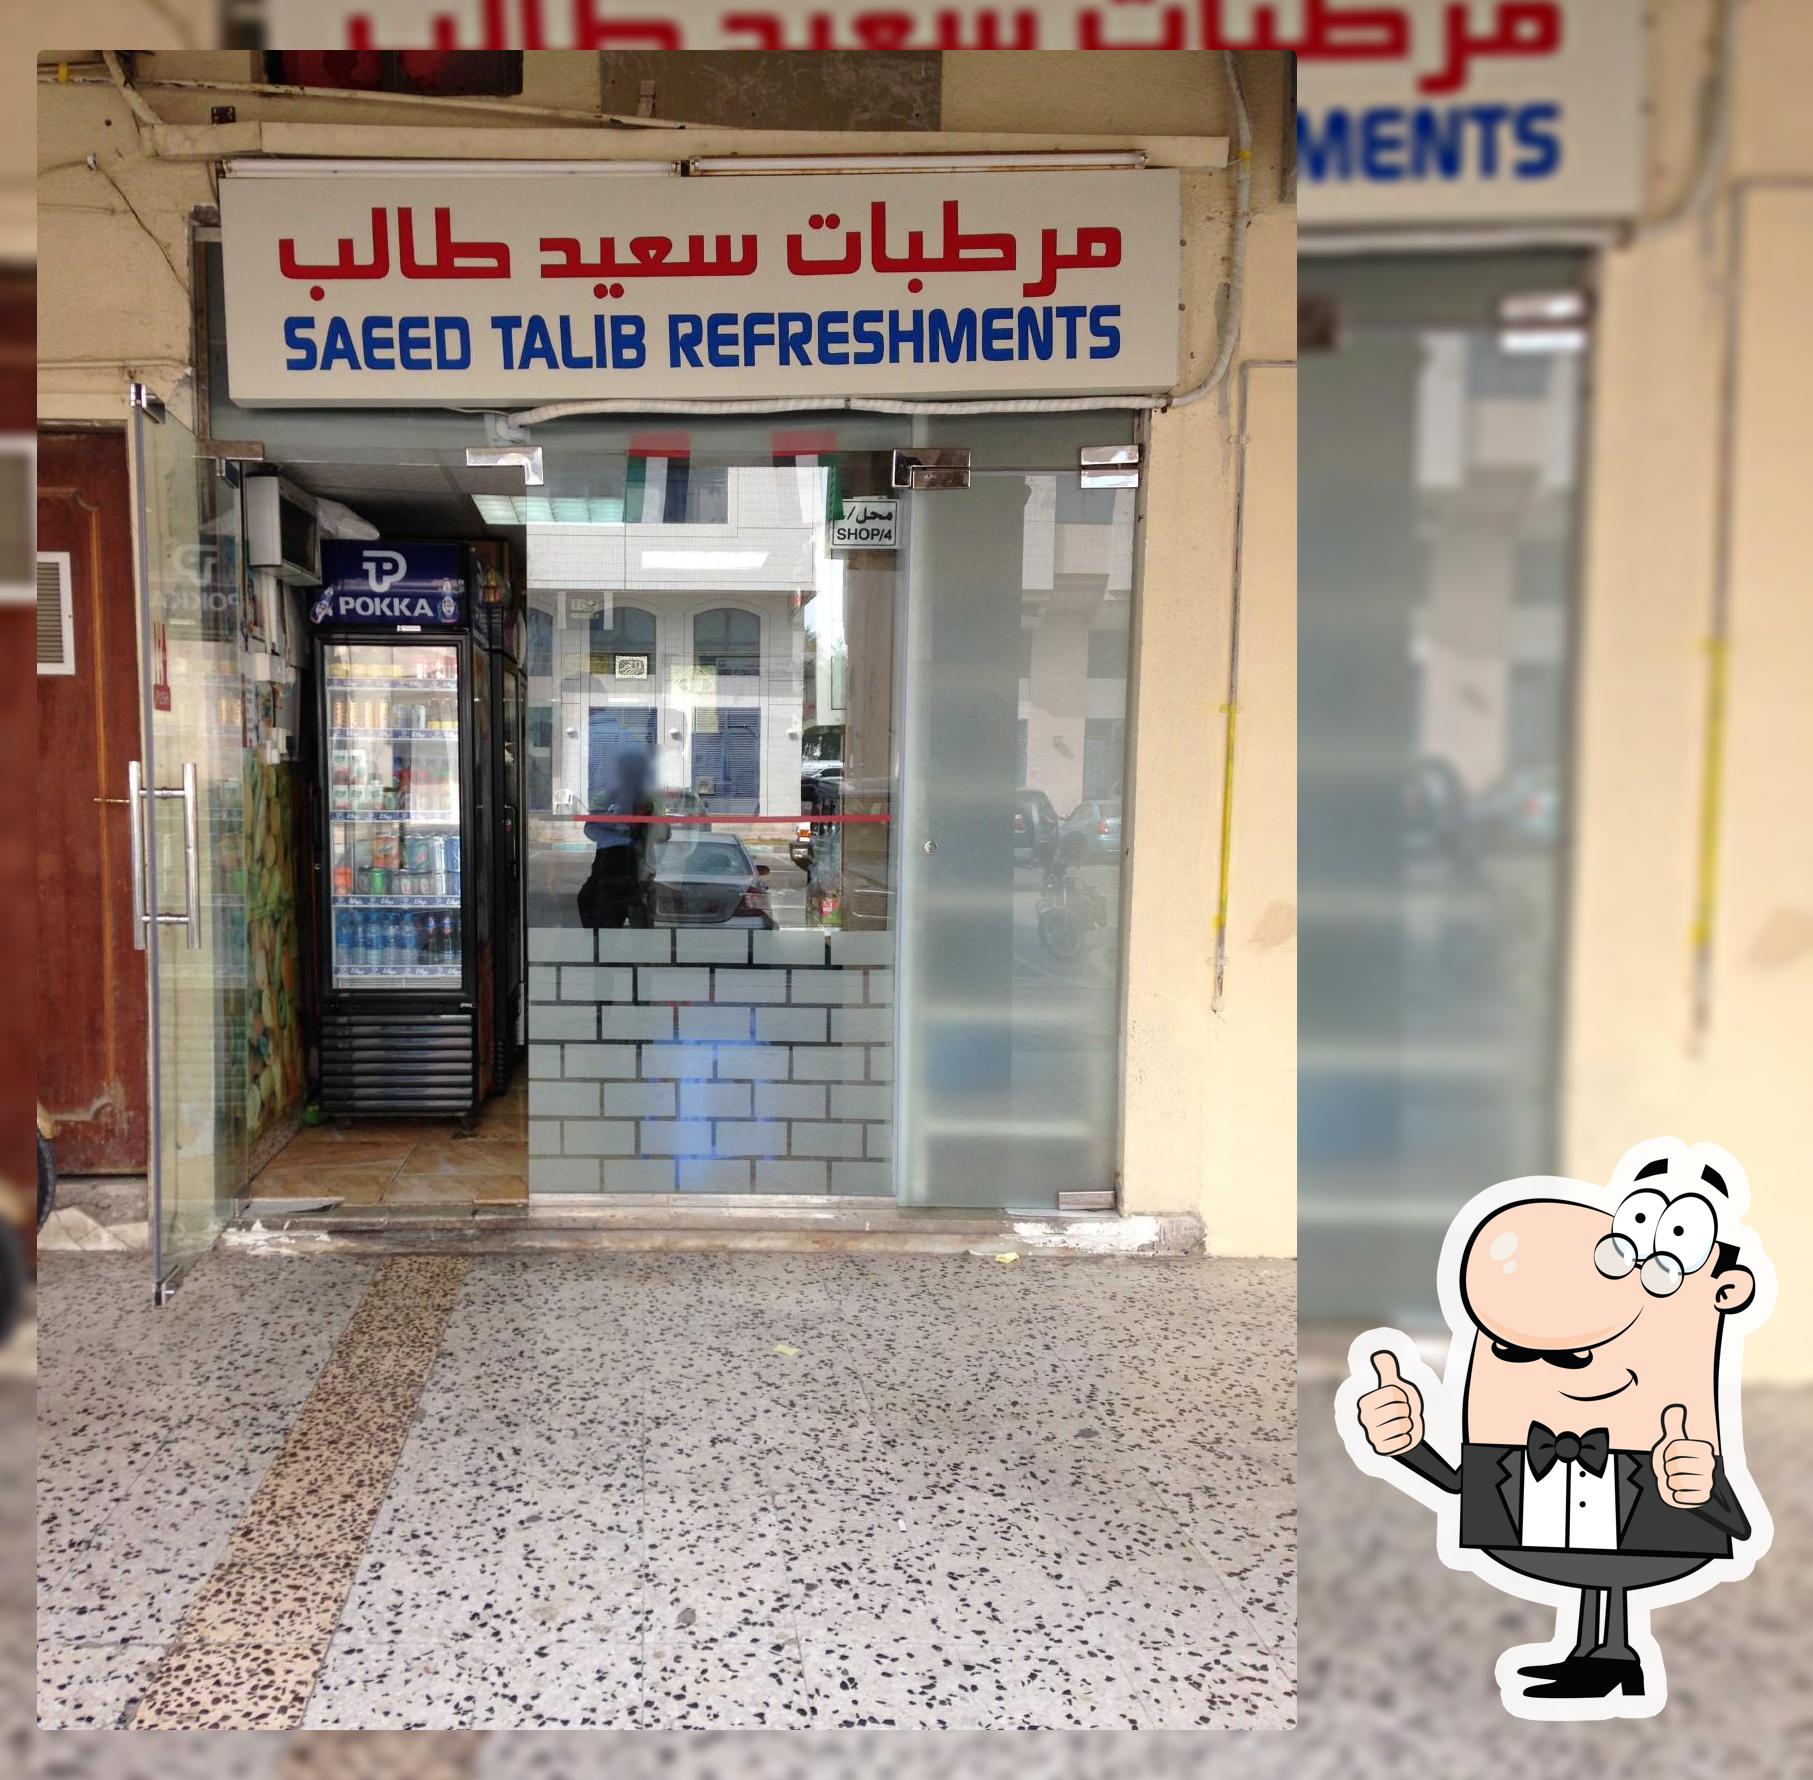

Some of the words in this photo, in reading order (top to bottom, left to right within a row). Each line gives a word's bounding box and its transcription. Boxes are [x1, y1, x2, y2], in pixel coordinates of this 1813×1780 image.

[278, 207, 512, 301] طالب
[539, 234, 758, 299] سعيد
[786, 200, 1122, 298] مرطبات
[284, 315, 472, 372] SAEED
[491, 314, 646, 370] TALIB
[668, 304, 1122, 369] REFRESHMENTS
[837, 527, 893, 542] SHOP/4
[845, 506, 893, 524] محل/
[338, 596, 434, 617] POKKA
